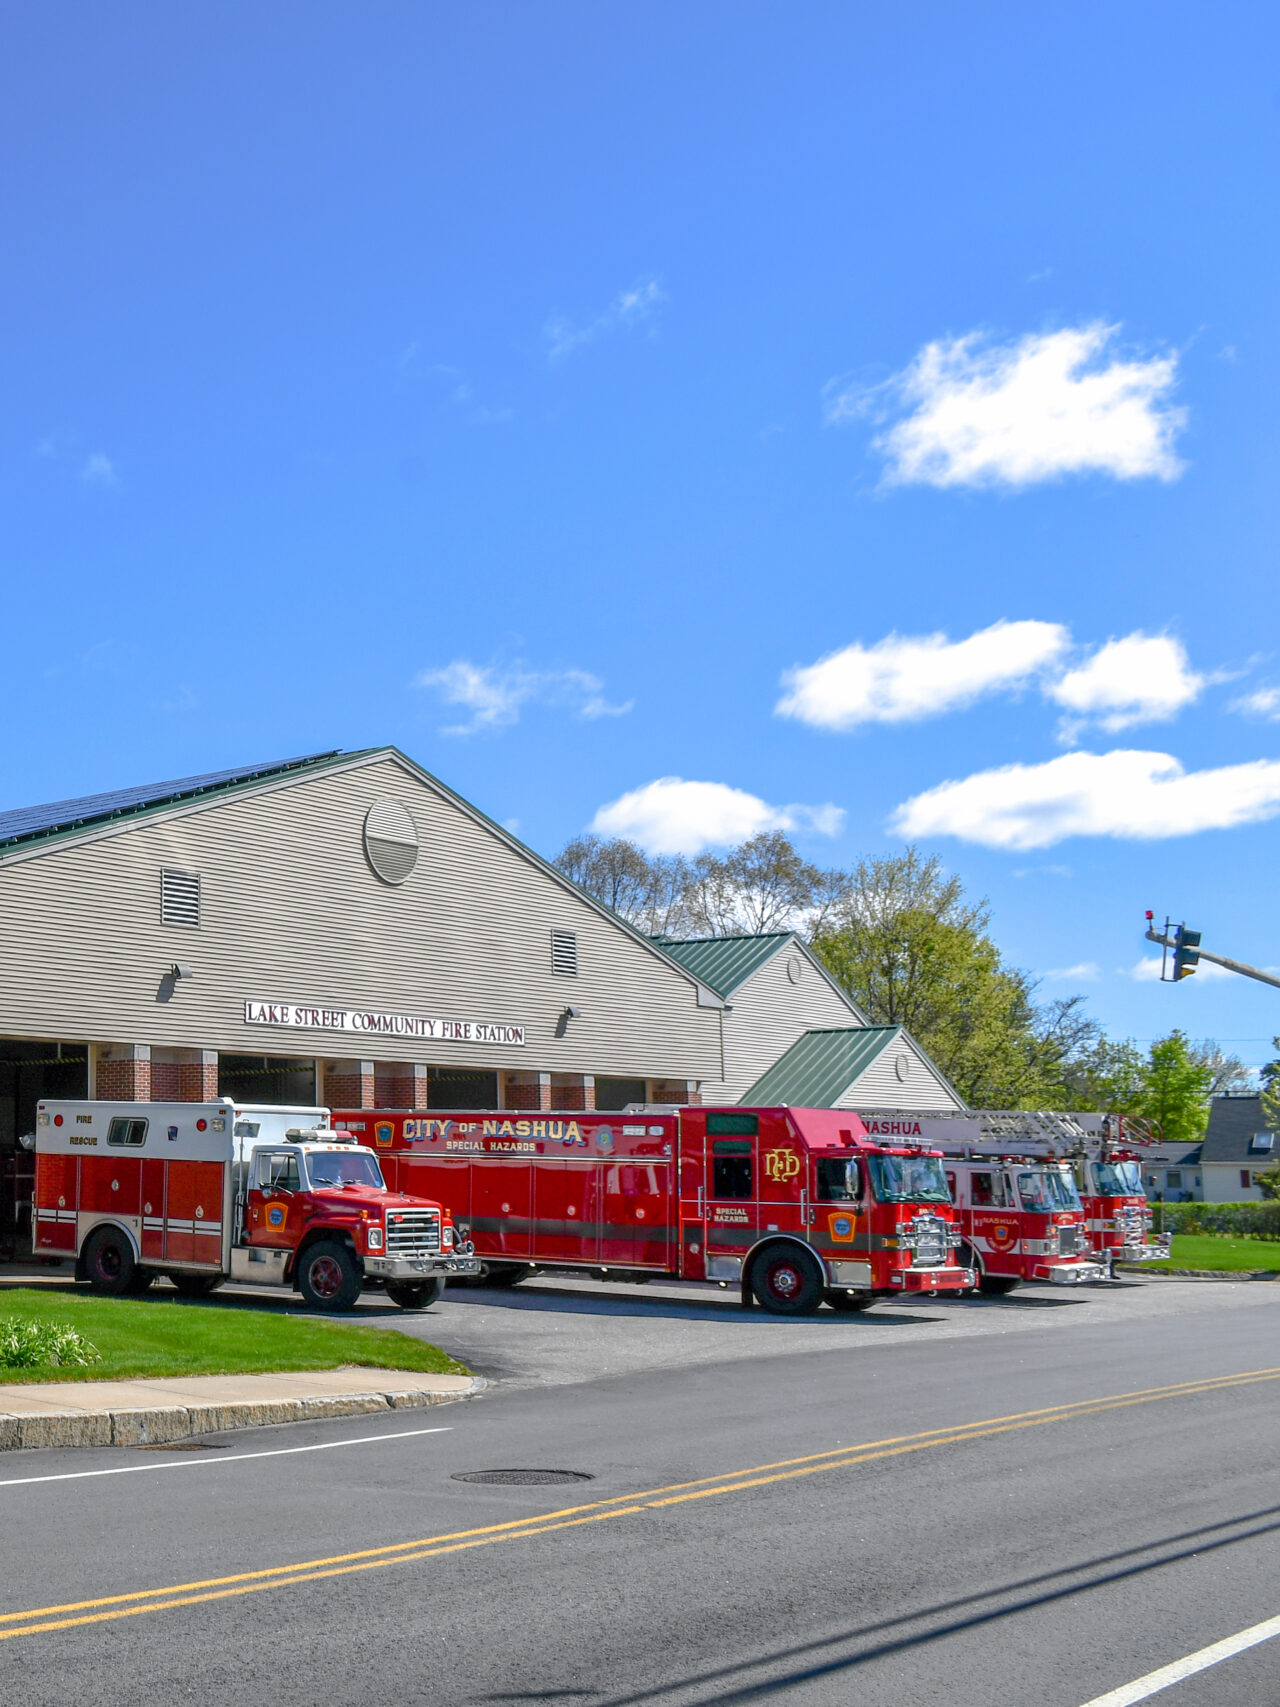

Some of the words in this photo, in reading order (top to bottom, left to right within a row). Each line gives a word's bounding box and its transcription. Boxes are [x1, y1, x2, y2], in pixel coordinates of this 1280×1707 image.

[247, 1003, 289, 1023] LAKE
[295, 1008, 347, 1028] STREET
[352, 1013, 436, 1036] COMMUNITY
[442, 1021, 472, 1039] FIRE
[475, 1024, 523, 1043] STATION
[76, 1115, 92, 1124] FIRE
[403, 1119, 453, 1141] CITY
[459, 1122, 477, 1133] OF
[482, 1120, 585, 1145] NASHUA
[861, 1121, 921, 1135] NASHUA
[70, 1136, 98, 1146] RESCUE
[446, 1141, 485, 1151] SPECIAL
[490, 1141, 536, 1152] HAZARDS
[716, 1207, 747, 1216] SPECIAL
[714, 1215, 749, 1223] HAZARDS
[983, 1217, 1019, 1225] NASHUA
